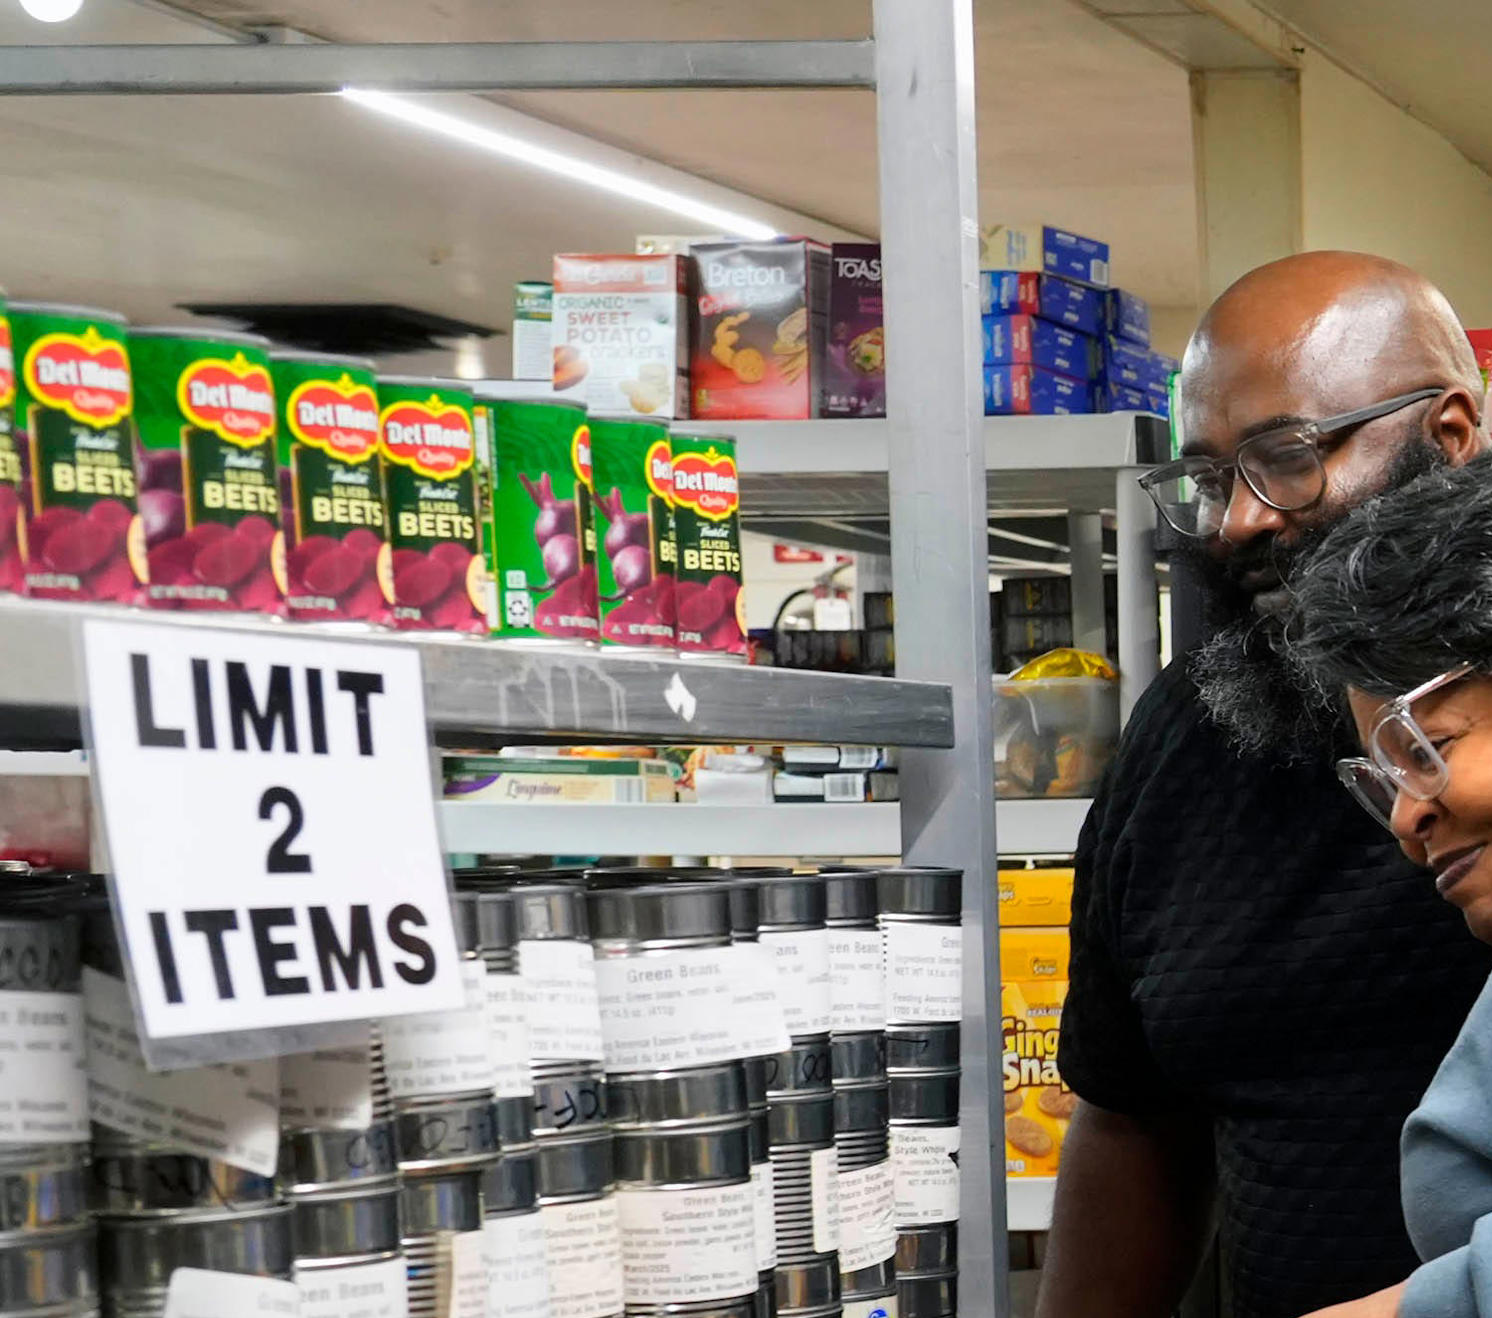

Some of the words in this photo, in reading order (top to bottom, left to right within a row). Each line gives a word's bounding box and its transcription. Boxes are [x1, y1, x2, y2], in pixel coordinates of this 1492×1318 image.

[708, 262, 785, 288] Breton
[834, 257, 883, 281] TOAS
[559, 296, 625, 309] ORGANIC
[567, 311, 633, 325] SWEET
[566, 327, 651, 343] POTATO
[37, 356, 78, 385] Del
[189, 380, 228, 409] Del
[298, 400, 336, 427] Del
[386, 420, 423, 446] Del
[53, 463, 137, 498] BEETS
[674, 470, 703, 490] Del
[203, 481, 279, 514] BEETS
[312, 496, 383, 528] BEETS
[399, 512, 475, 540] BEETS
[684, 550, 741, 573] BEETS
[130, 653, 385, 757] LIMIT
[256, 786, 313, 875] 2
[148, 902, 437, 1004] ITEMS
[776, 946, 798, 956] ans
[828, 942, 849, 953] een
[627, 968, 673, 984] Green
[679, 963, 722, 979] Beans
[1001, 1016, 1061, 1059] Ging
[1002, 1052, 1072, 1094] Sna
[300, 1287, 330, 1302] een
